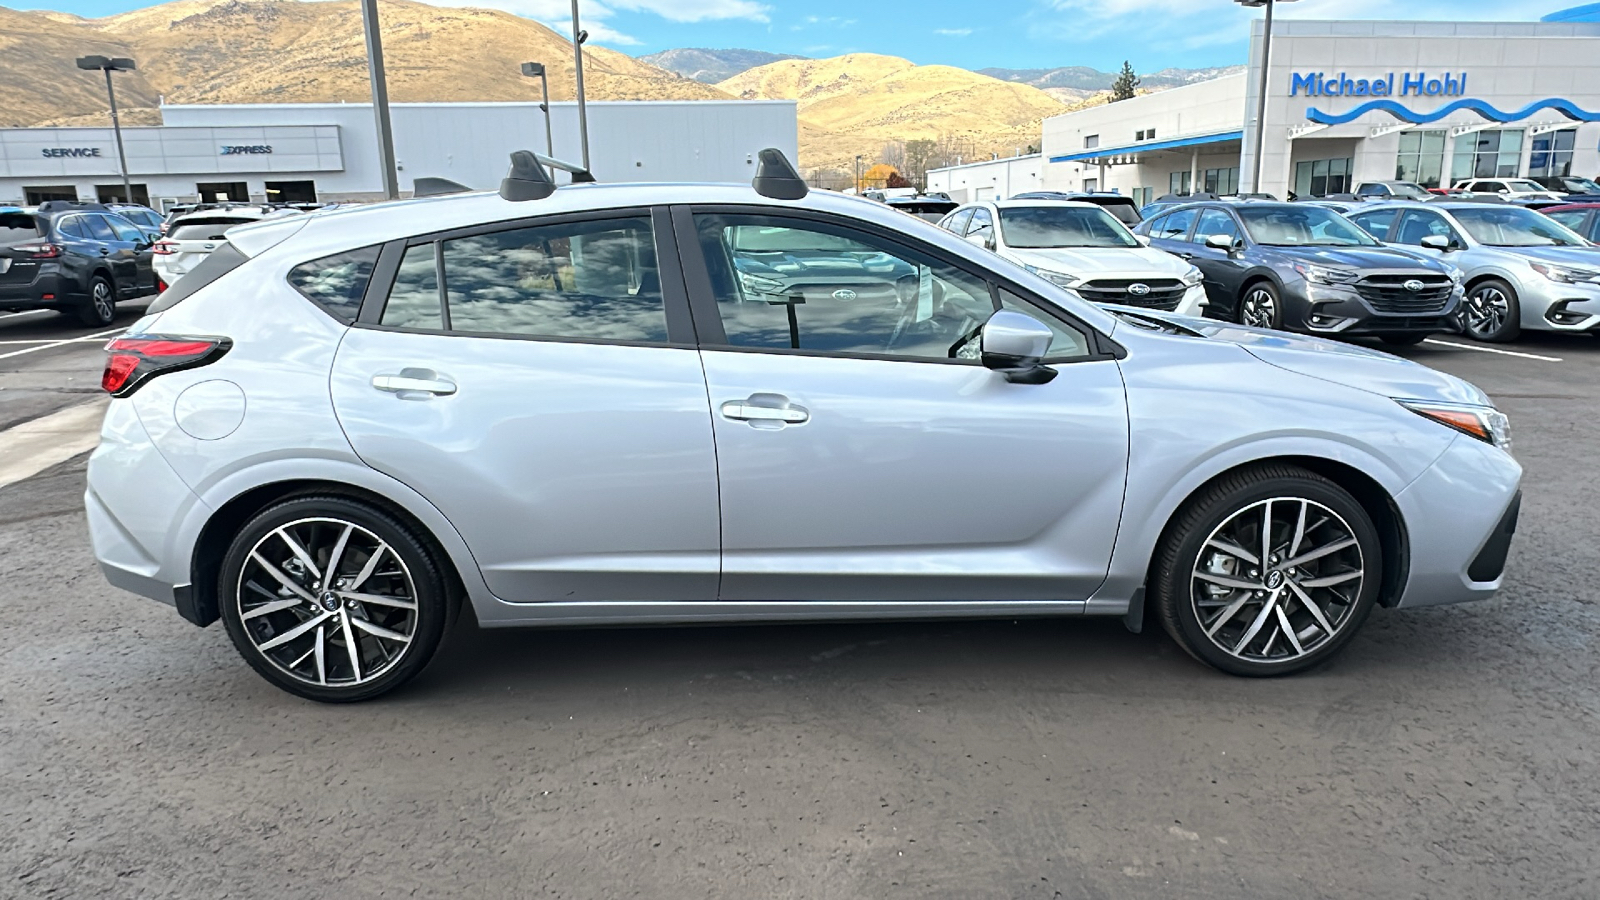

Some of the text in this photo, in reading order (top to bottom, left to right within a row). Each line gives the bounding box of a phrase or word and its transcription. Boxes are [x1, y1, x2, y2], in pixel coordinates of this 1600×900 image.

[1290, 72, 1467, 96] Michael Hohl
[42, 147, 101, 158] SERVICE
[222, 145, 273, 155] EXPRESS
